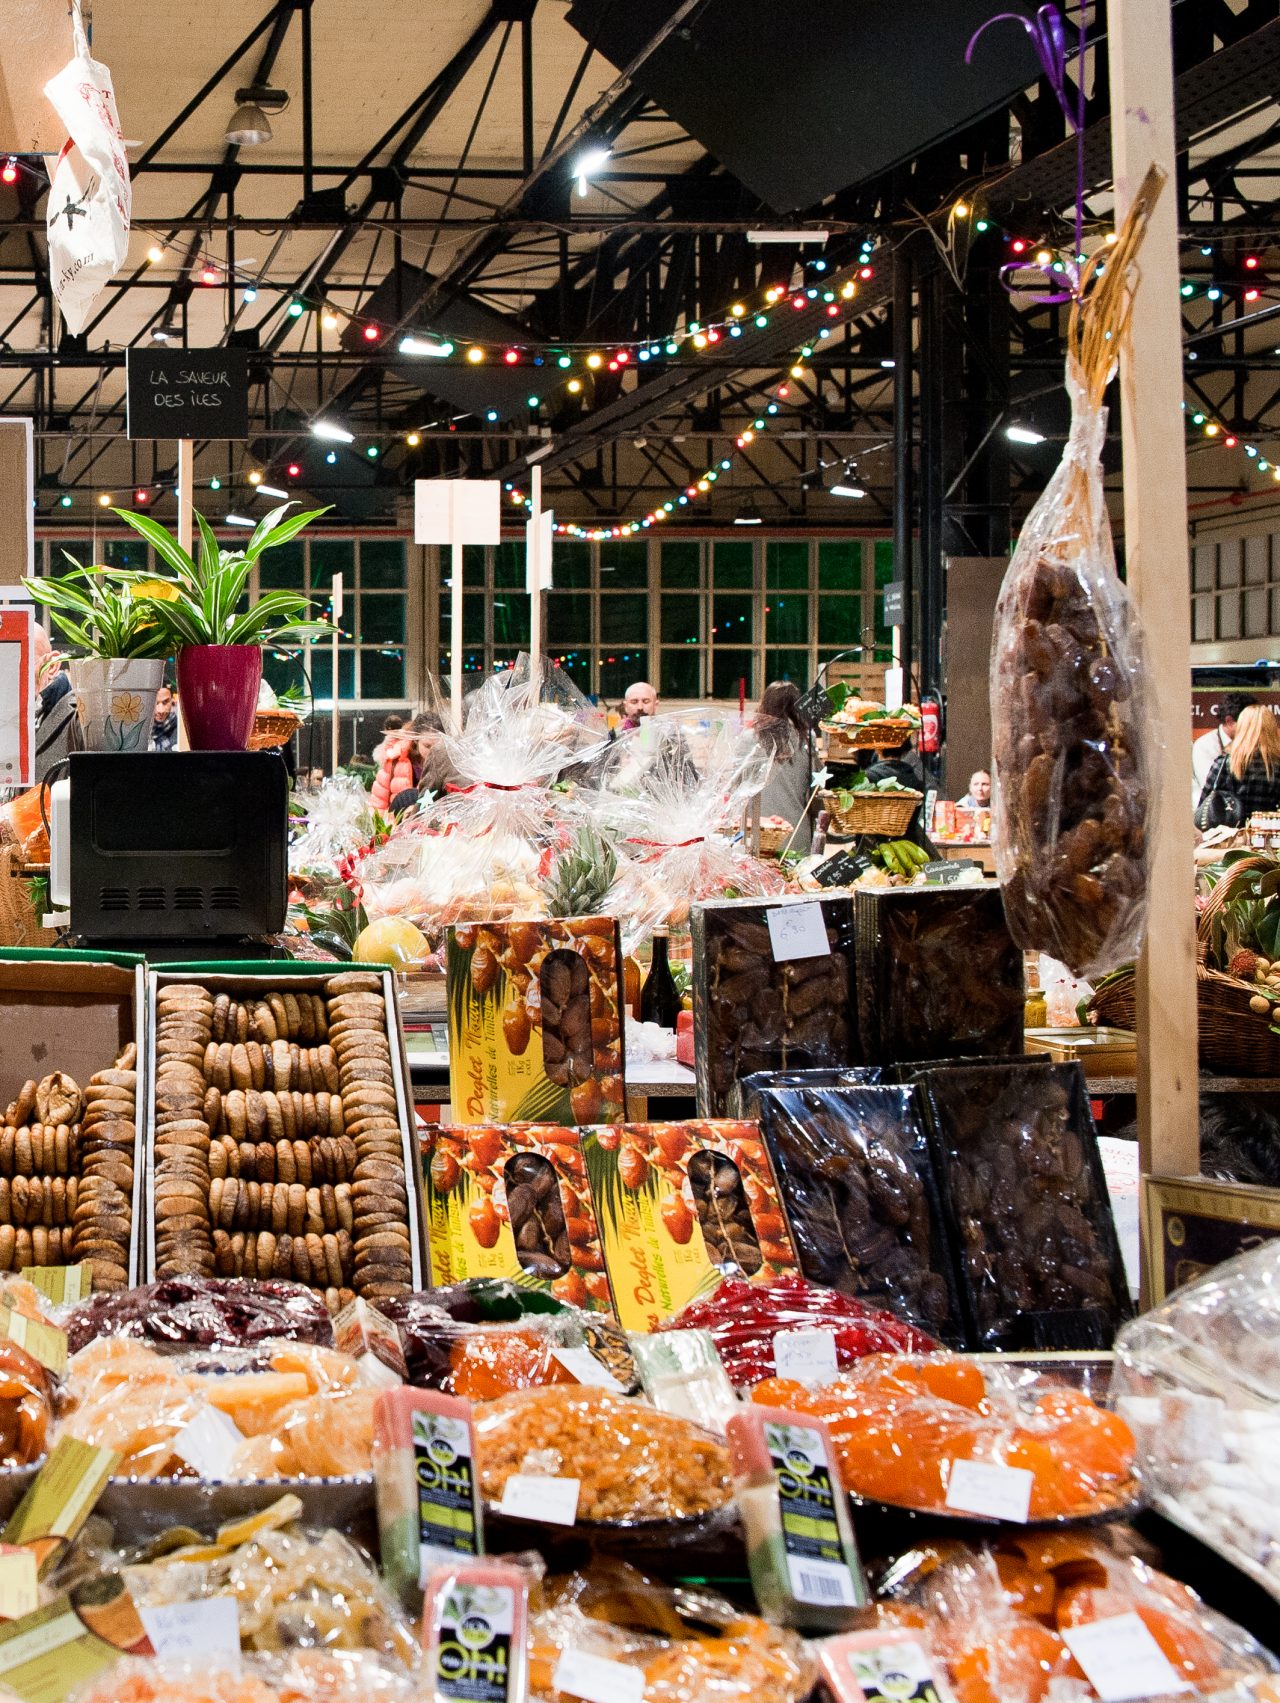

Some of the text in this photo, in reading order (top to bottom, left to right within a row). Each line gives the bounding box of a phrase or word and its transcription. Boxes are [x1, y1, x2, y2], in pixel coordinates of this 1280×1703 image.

[150, 370, 231, 388] LA SAVEUR
[154, 393, 185, 408] DES
[485, 1046, 497, 1060] de
[466, 1055, 489, 1117] Deglet
[630, 1246, 656, 1307] Deglet
[652, 1253, 673, 1311] Naturelles
